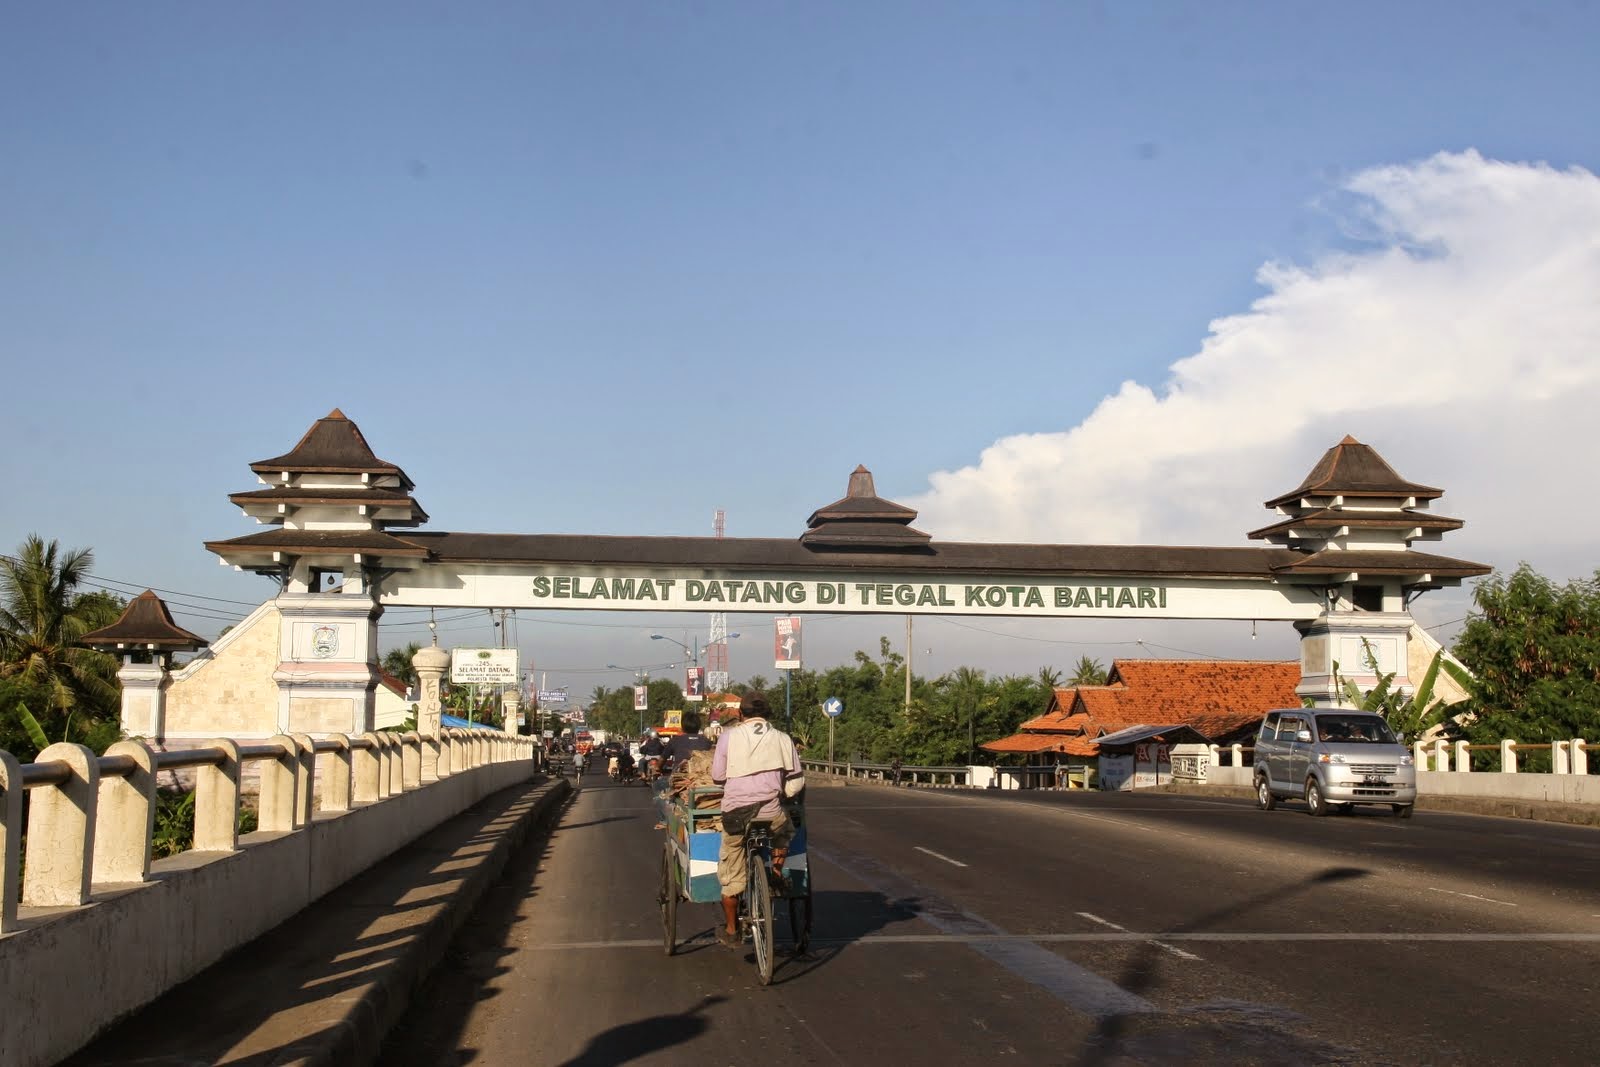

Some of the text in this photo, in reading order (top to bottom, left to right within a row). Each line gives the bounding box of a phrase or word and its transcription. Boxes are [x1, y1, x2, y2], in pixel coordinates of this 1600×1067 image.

[533, 576, 1167, 609] SELAMAT DATANG DI TEGAL KOTA BAHARI
